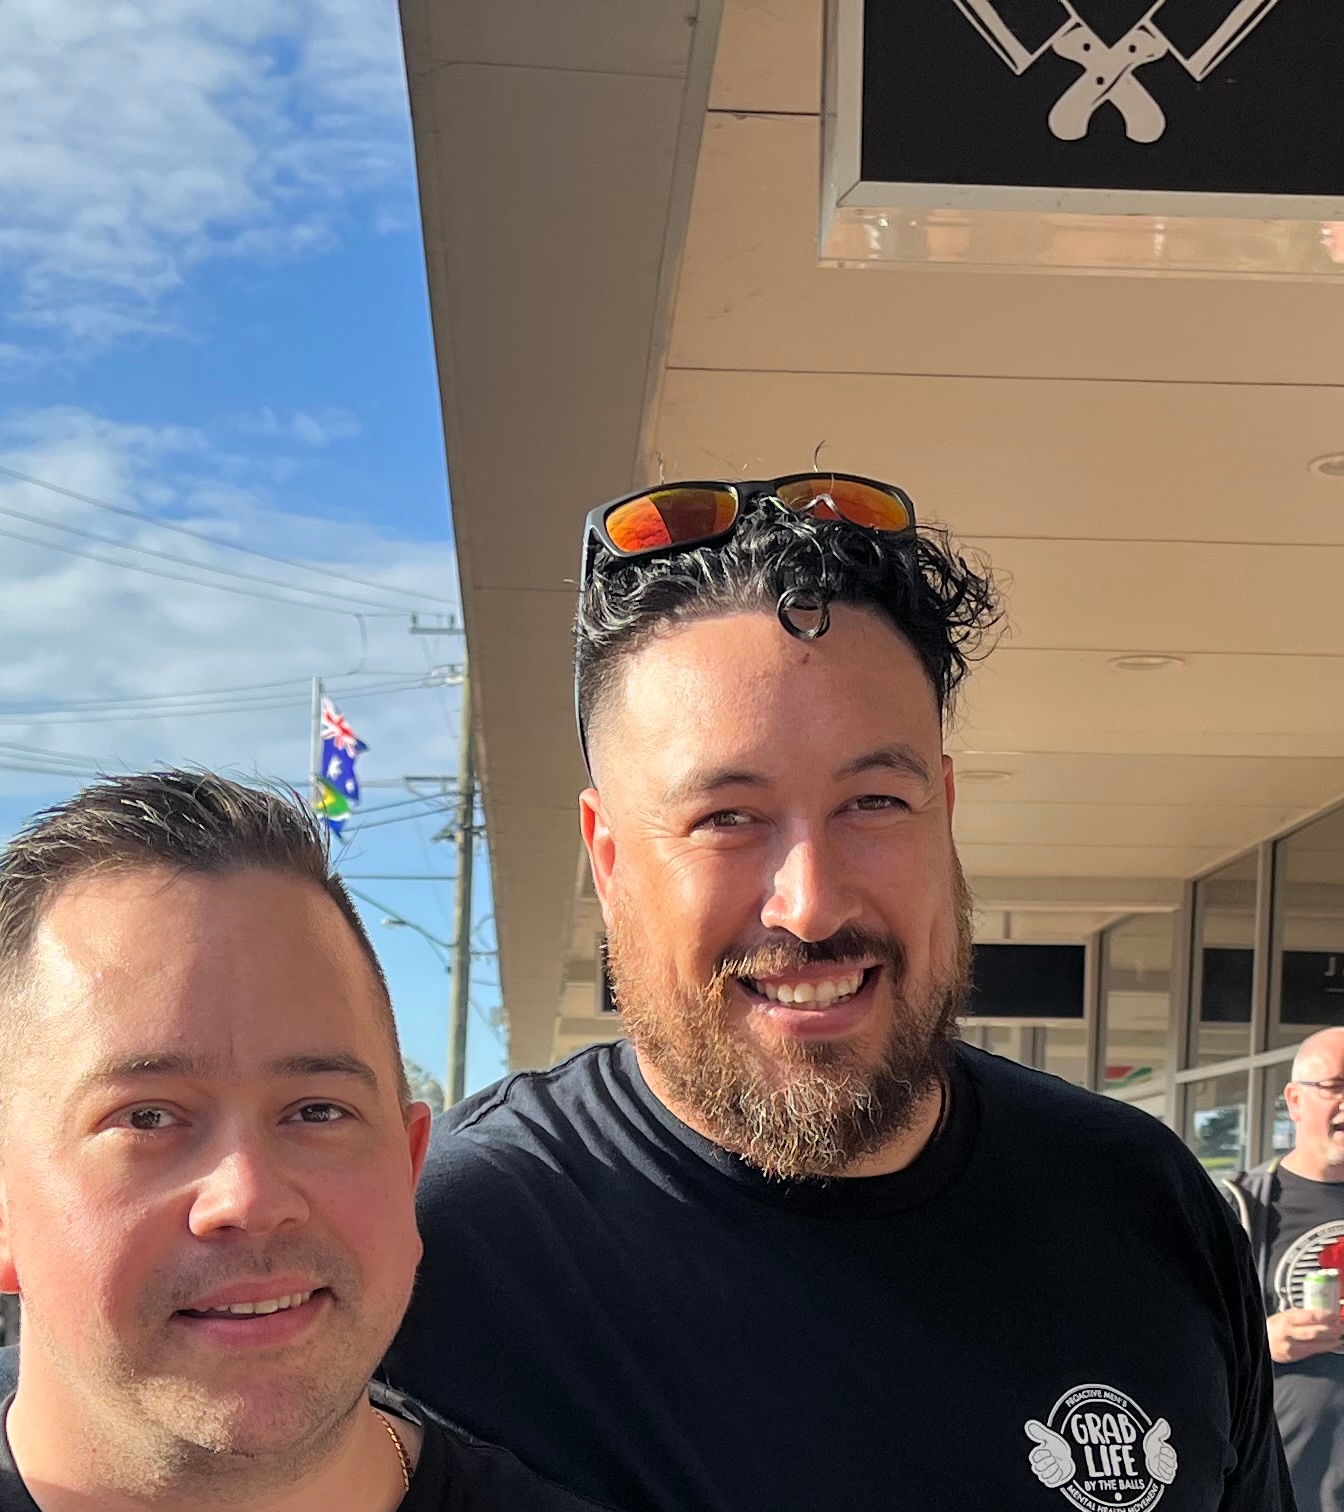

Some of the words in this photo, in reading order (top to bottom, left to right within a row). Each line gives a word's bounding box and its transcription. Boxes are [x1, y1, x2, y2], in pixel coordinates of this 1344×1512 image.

[1065, 1389, 1103, 1408] PROACTIVE
[1070, 1412, 1137, 1445] GRAB
[1084, 1444, 1139, 1478] LIFE
[1066, 1484, 1096, 1511] MENTAL
[1084, 1480, 1097, 1492] BY
[1098, 1479, 1118, 1491] THE
[1118, 1478, 1146, 1491] BALLS
